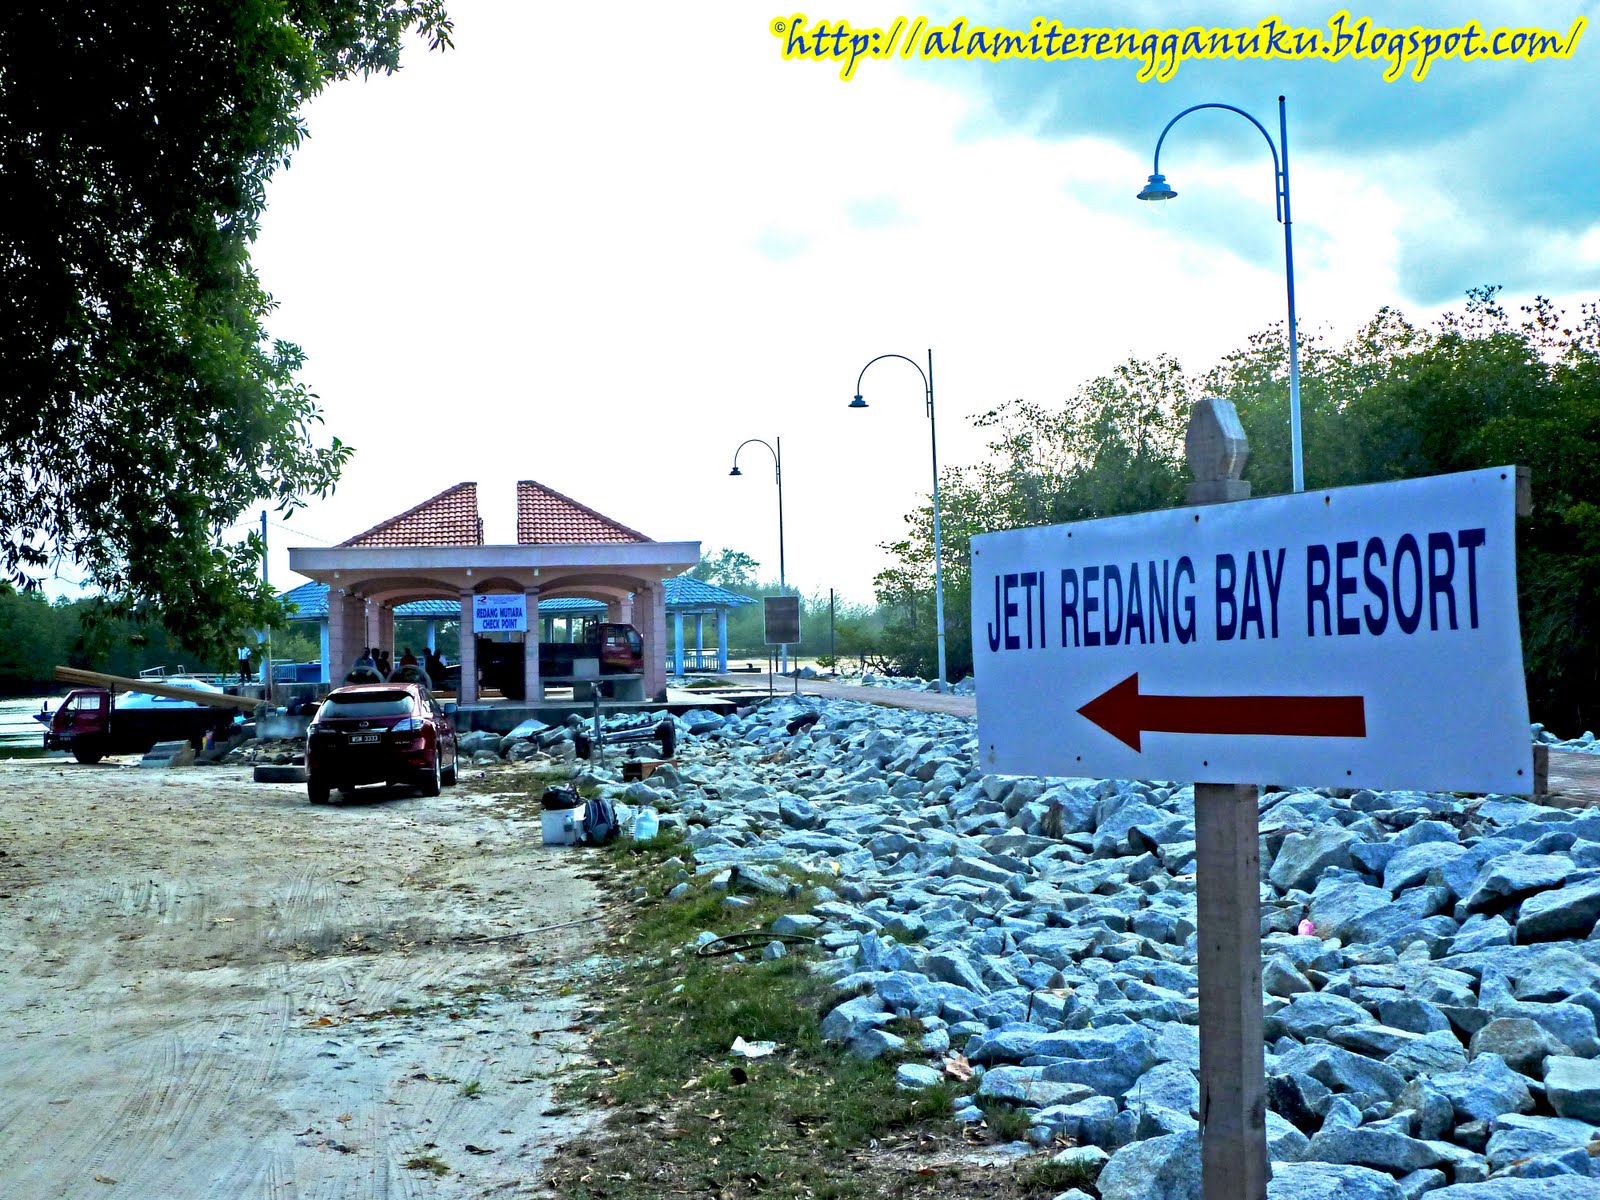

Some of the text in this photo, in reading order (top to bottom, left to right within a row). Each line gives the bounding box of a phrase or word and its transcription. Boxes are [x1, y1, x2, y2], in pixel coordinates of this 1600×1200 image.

[987, 527, 1486, 653] JETI REDANG BAY RESORT
[476, 607, 523, 618] REDANG MUTIARA
[483, 618, 517, 629] CHECK POINT
